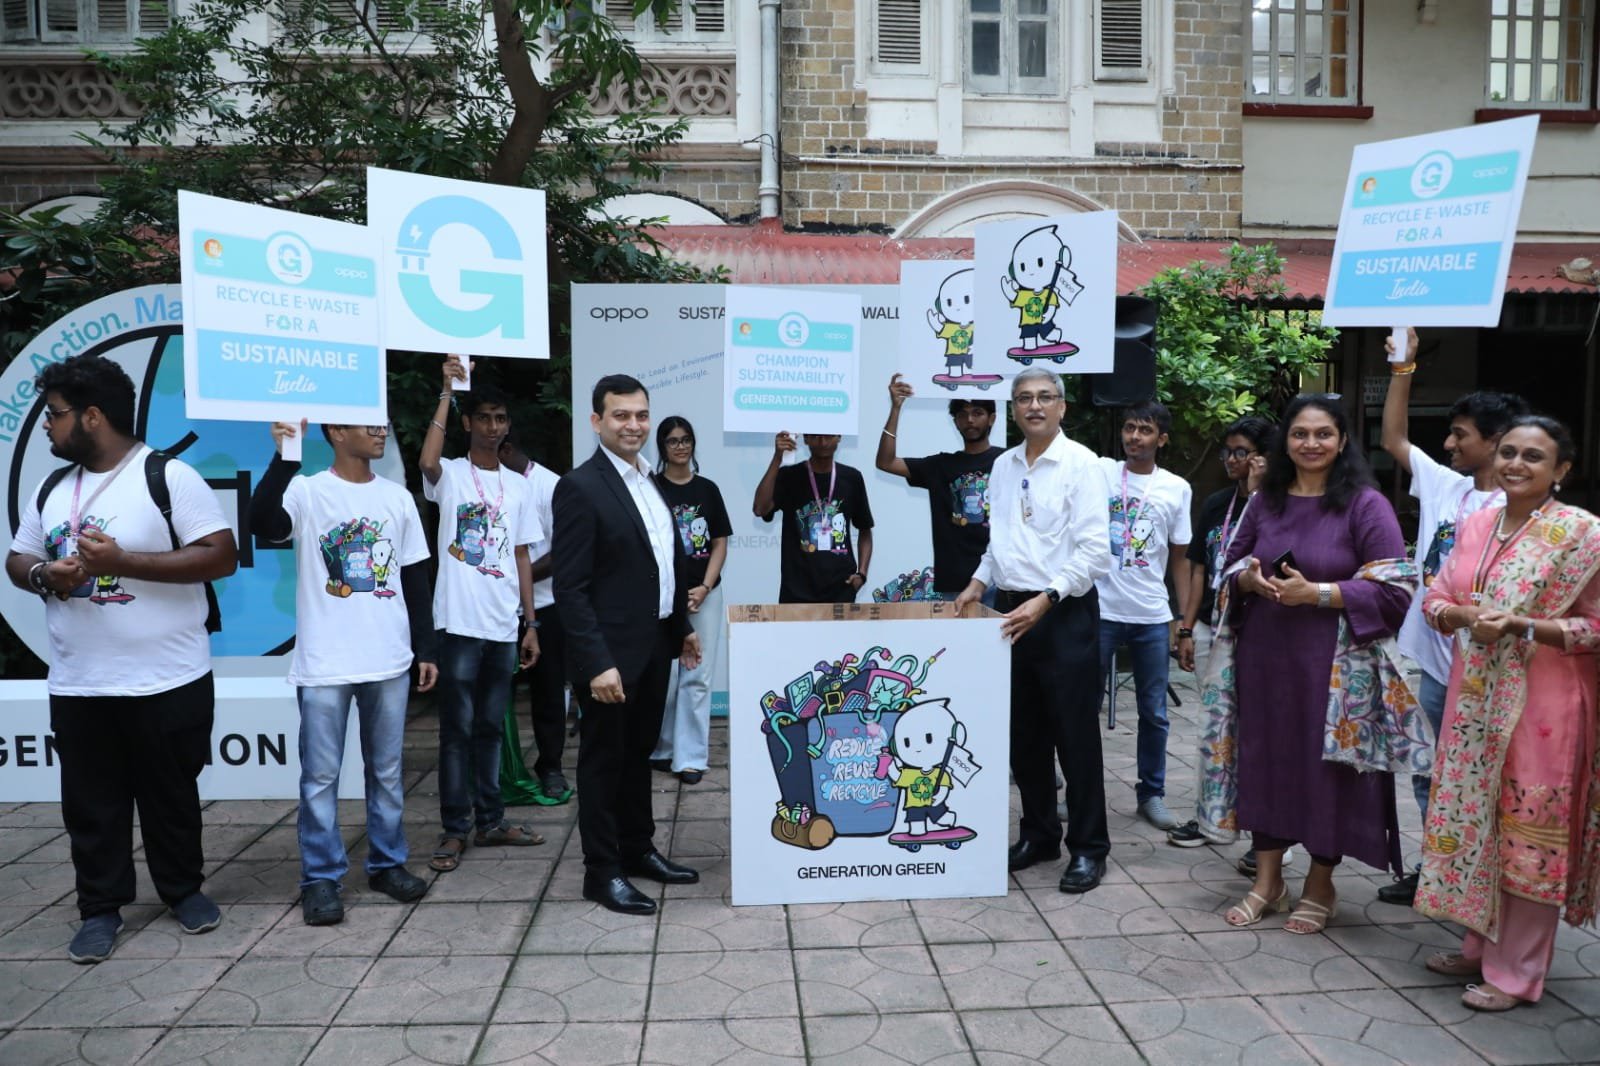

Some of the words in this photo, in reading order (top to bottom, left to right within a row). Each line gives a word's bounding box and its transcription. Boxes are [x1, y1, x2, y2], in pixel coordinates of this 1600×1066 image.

[1362, 209, 1421, 225] RECYCLE
[1425, 201, 1491, 221] E-WASTE
[1432, 226, 1443, 239] A
[334, 267, 368, 279] oppo
[1355, 252, 1478, 275] SUSTAINABLE
[1386, 277, 1430, 300] India
[216, 284, 289, 308] RECYCLE
[294, 295, 360, 316] E-WASTE
[590, 307, 649, 322] oppo
[308, 319, 319, 333] A
[29, 312, 130, 376] Action.
[220, 341, 359, 370] SUSTAINABLE
[755, 353, 829, 369] CHAMPION
[268, 370, 318, 394] India
[738, 368, 845, 385] SUSTAINABILITY
[740, 393, 810, 406] GENERATION
[811, 395, 843, 407] GREEN
[829, 737, 881, 760] REDUCE
[834, 761, 877, 781] REUSE
[952, 755, 971, 773] oppo
[797, 864, 892, 879] GENERATION
[895, 862, 945, 876] GREEN
